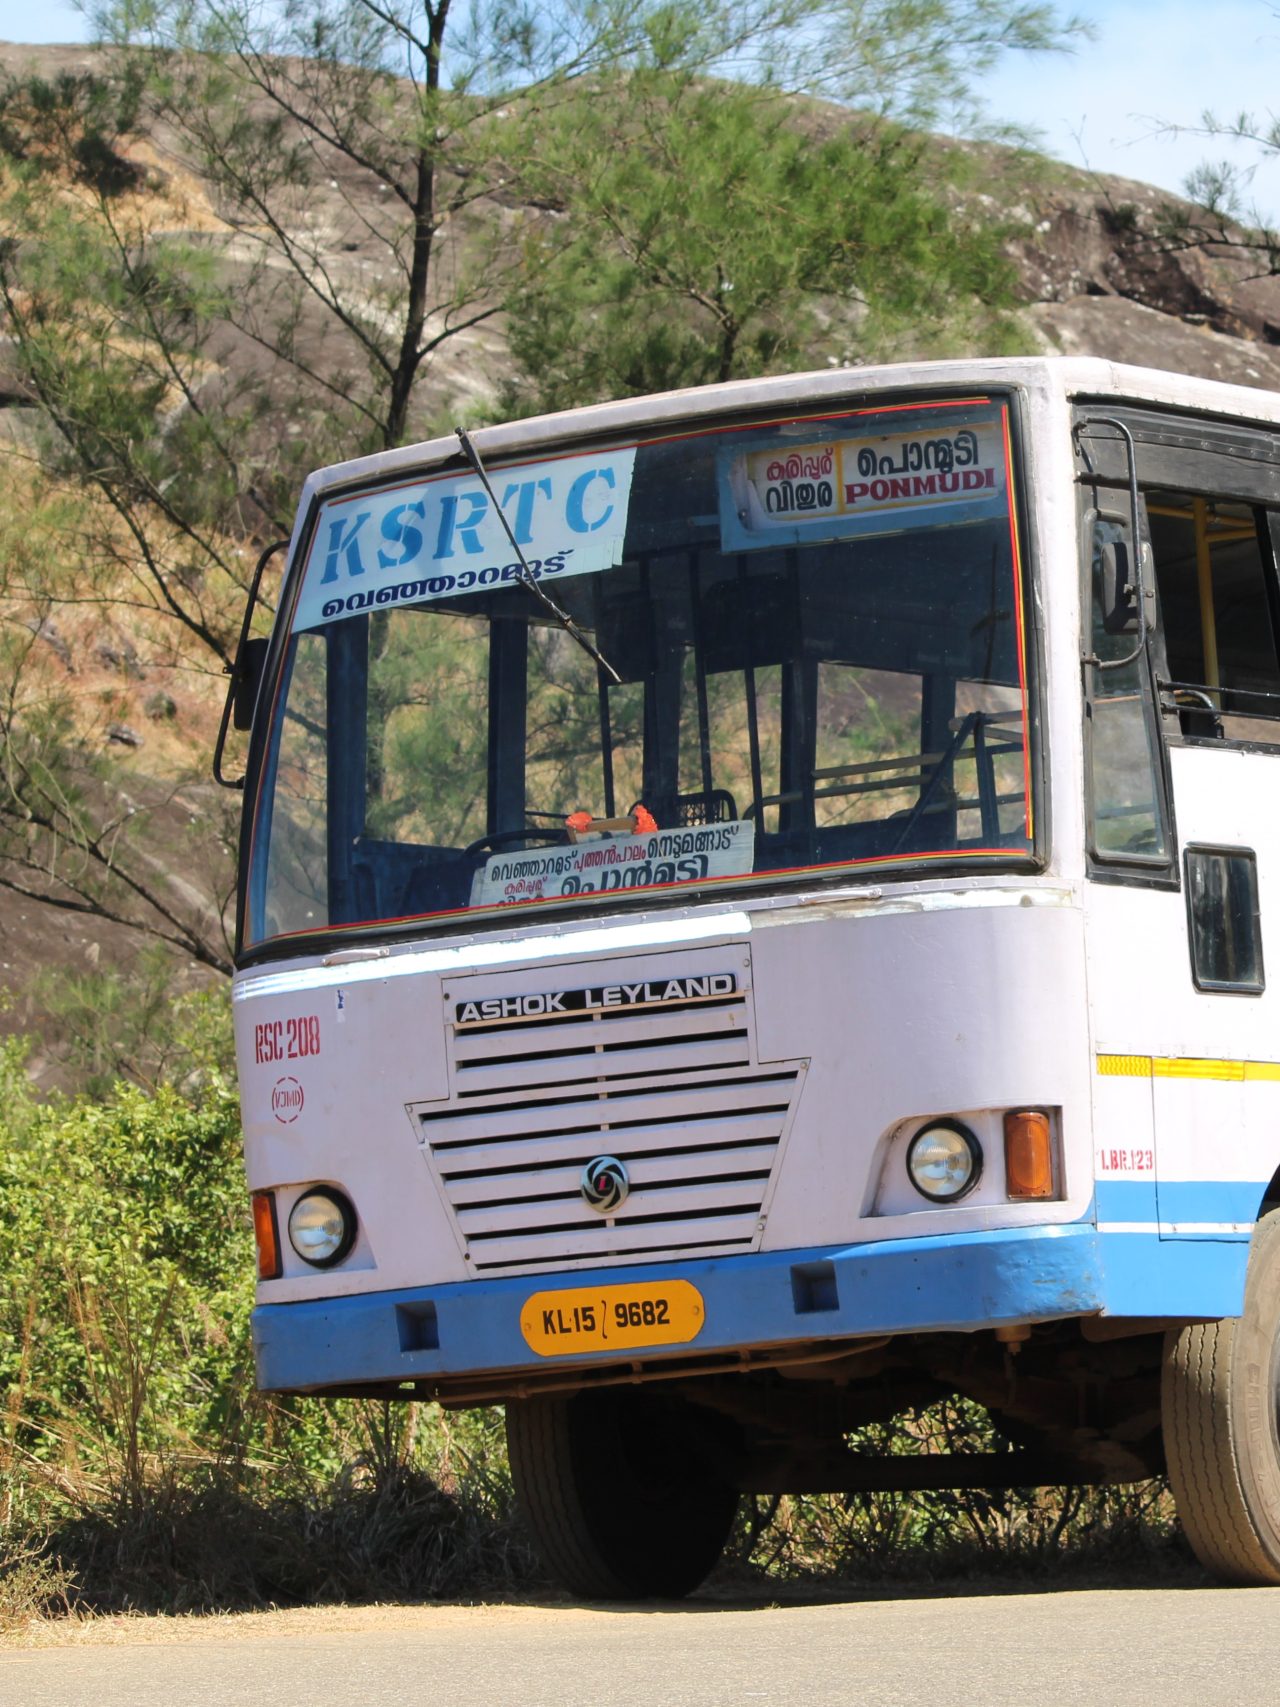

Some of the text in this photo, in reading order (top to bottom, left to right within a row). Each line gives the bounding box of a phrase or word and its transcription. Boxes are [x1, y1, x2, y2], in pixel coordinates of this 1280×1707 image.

[845, 467, 995, 504] PONMUDI
[320, 467, 616, 585] KSRTC
[460, 973, 733, 1023] ASHOK LEYLAND
[255, 1015, 321, 1064] RSC 208
[614, 1299, 670, 1328] 9682
